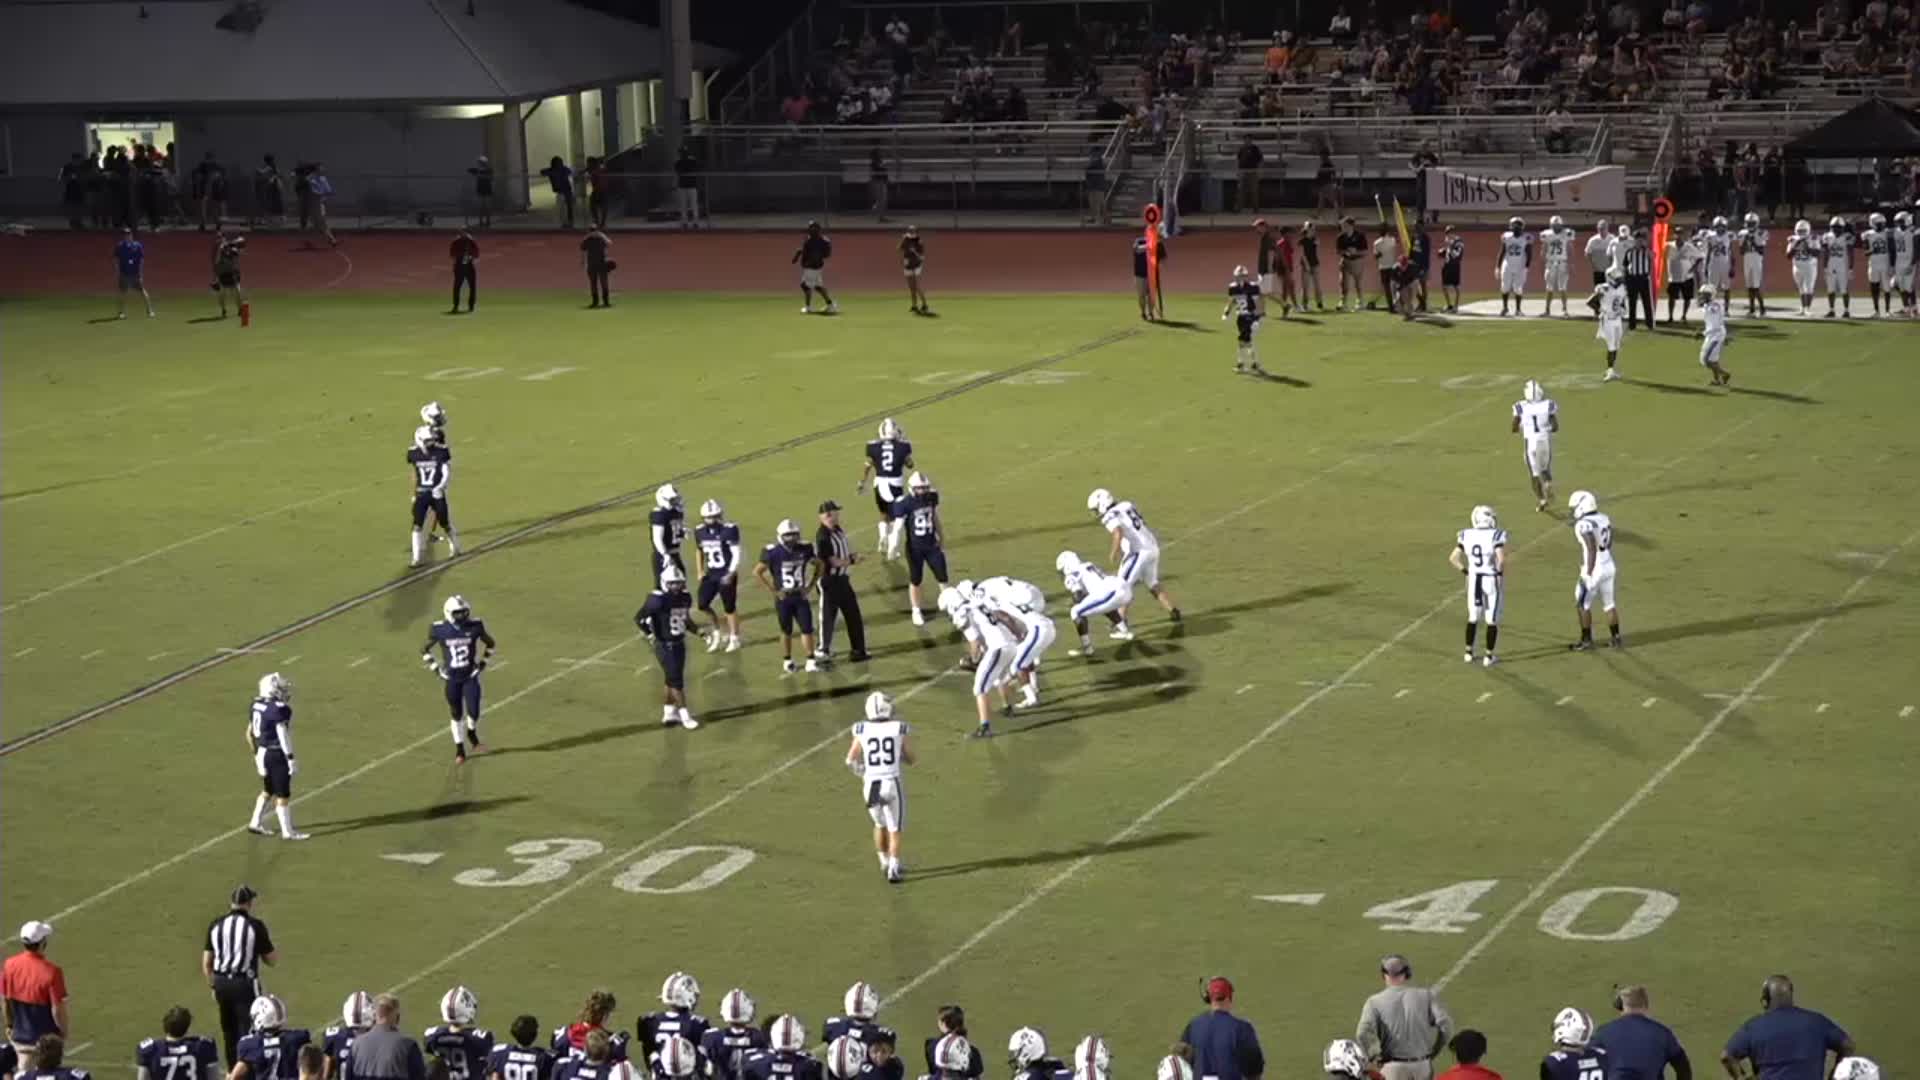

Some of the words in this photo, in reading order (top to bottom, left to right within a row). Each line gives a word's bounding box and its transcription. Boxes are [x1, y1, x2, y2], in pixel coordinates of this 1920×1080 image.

[1504, 176, 1560, 203] OUT
[1532, 414, 1540, 433] 1
[881, 450, 894, 472] 2
[419, 466, 436, 486] 17
[1471, 543, 1484, 568] 9
[449, 645, 470, 669] 12
[867, 736, 896, 767] 29
[452, 837, 755, 894] 30
[1361, 879, 1679, 942] 40
[160, 1055, 198, 1080] 73
